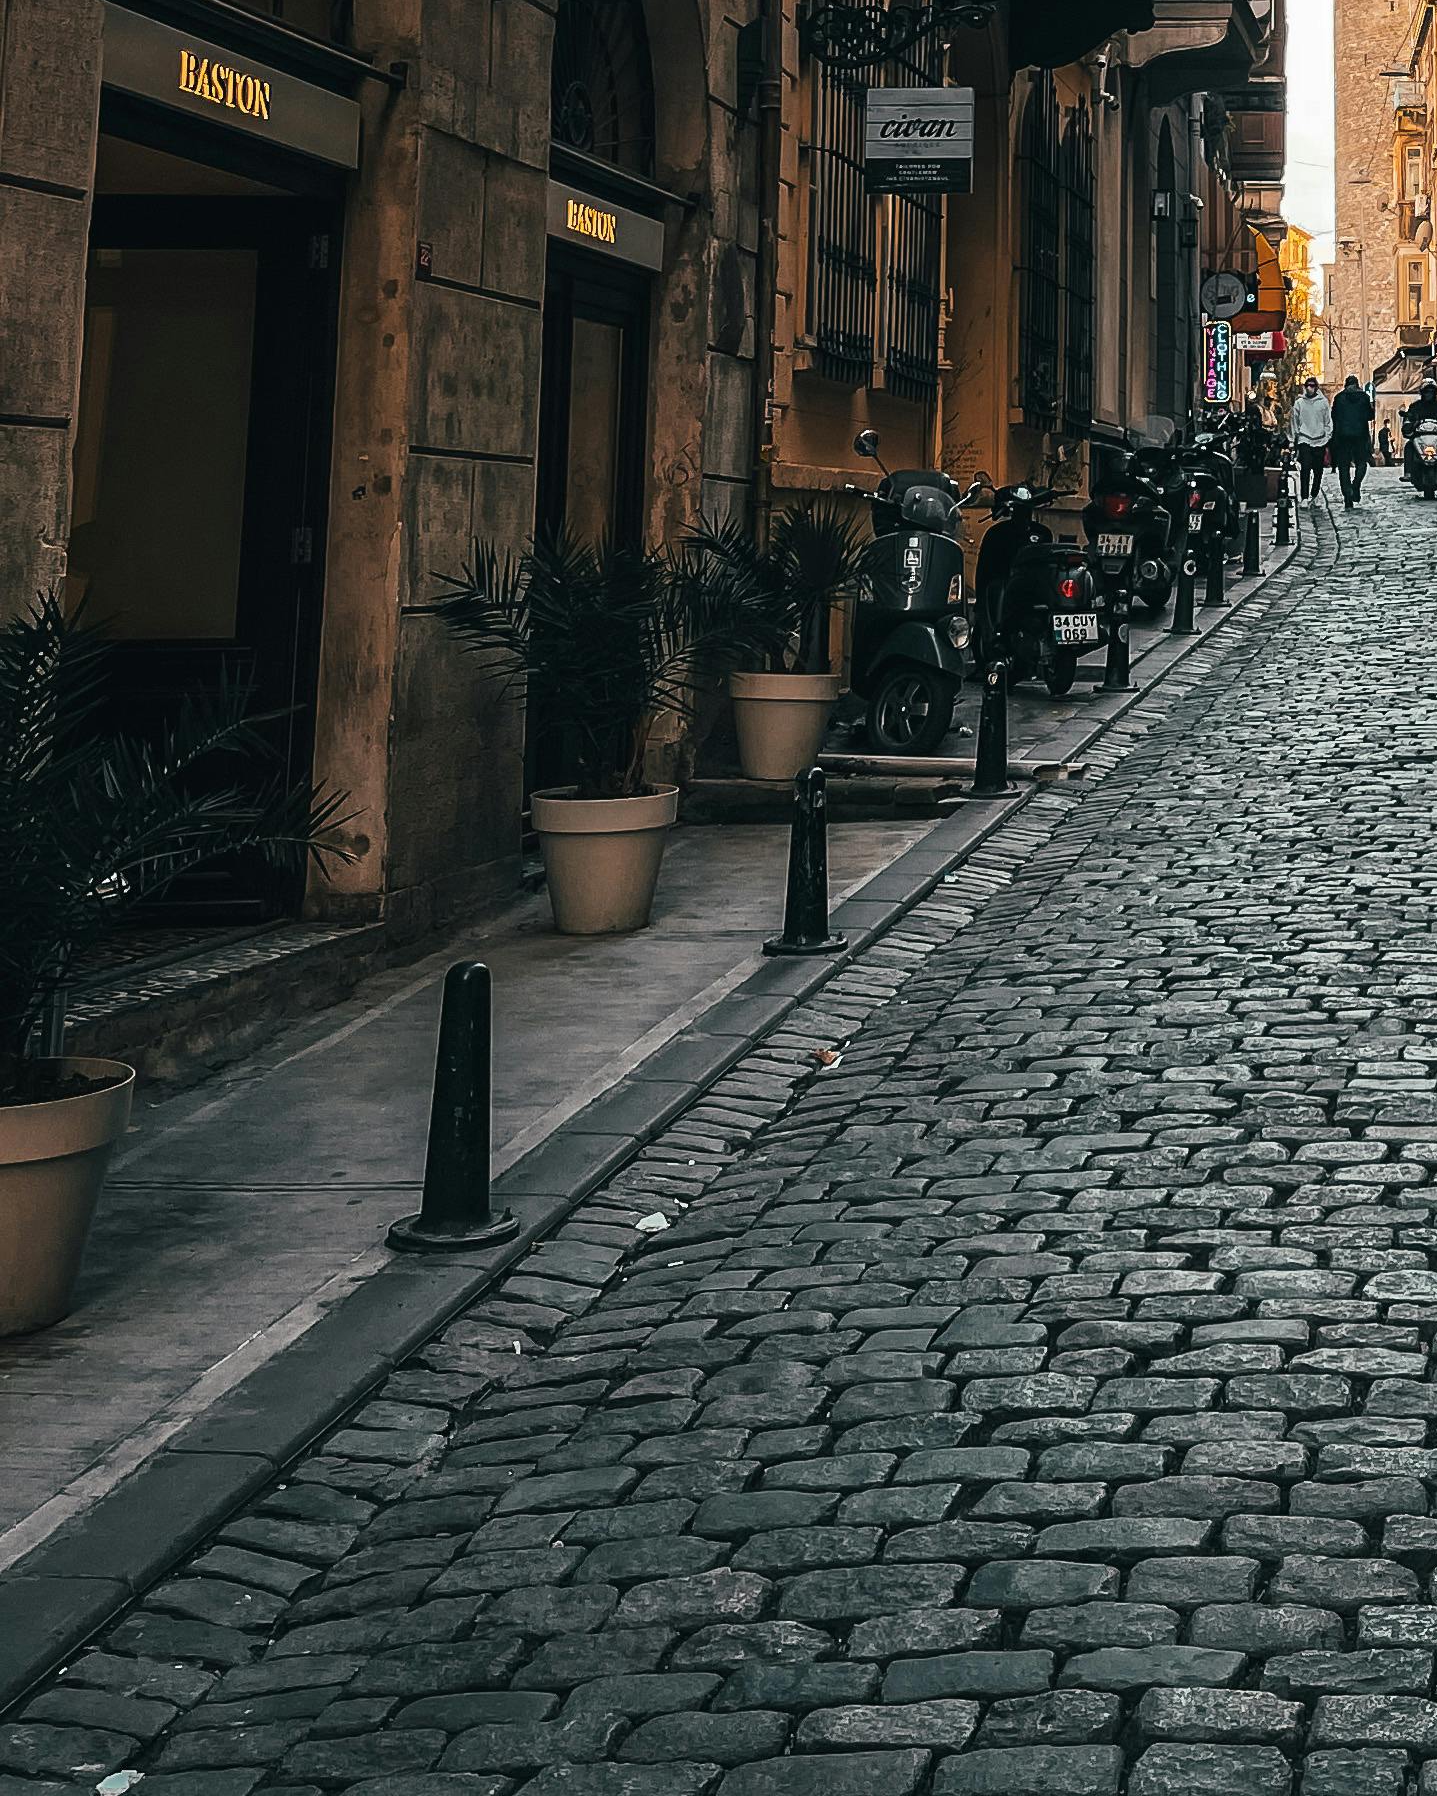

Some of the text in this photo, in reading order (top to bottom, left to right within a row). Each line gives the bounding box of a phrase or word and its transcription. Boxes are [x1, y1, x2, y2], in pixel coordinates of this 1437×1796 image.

[179, 50, 271, 120] BASTON
[880, 113, 957, 139] civan
[566, 198, 617, 244] BASTON
[1207, 328, 1217, 398] VINTAGE
[1217, 324, 1228, 399] CLOTHING
[1055, 615, 1096, 627] 34 CUY
[1064, 628, 1087, 640] 069
